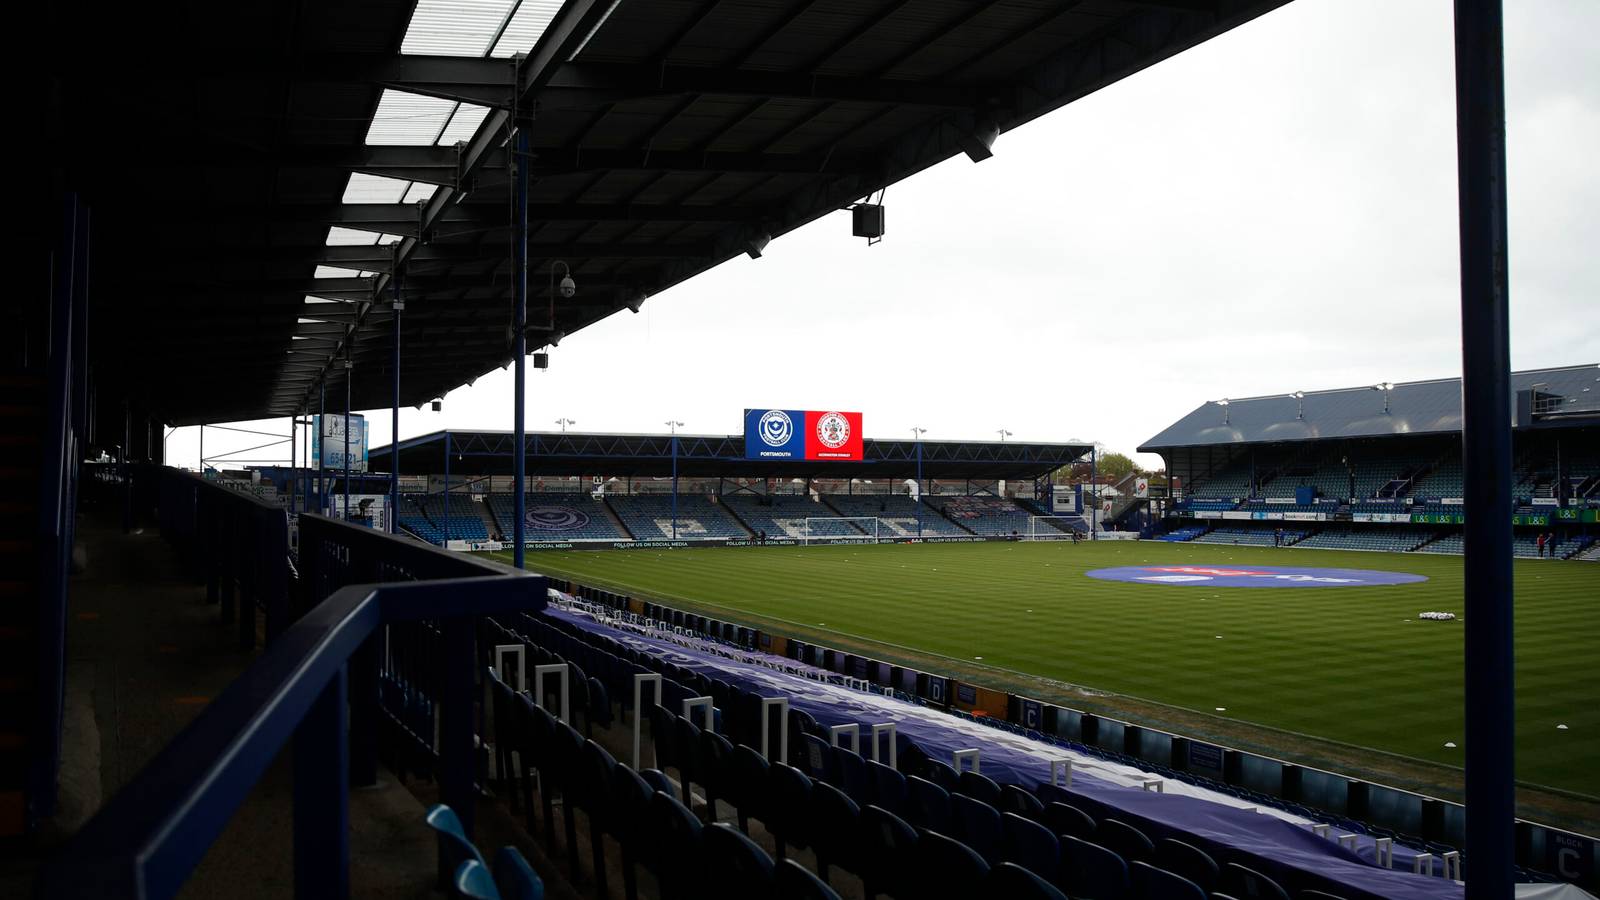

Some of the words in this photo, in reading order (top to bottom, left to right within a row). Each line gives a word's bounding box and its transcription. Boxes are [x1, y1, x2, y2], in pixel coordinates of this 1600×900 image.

[330, 452, 357, 465] 65421
[1415, 514, 1429, 523] L&S
[1435, 514, 1450, 523] L&S
[1528, 516, 1545, 525] L&S
[1560, 510, 1576, 519] L&S
[932, 683, 941, 701] D
[1027, 709, 1037, 728] C
[1558, 847, 1581, 879] C
